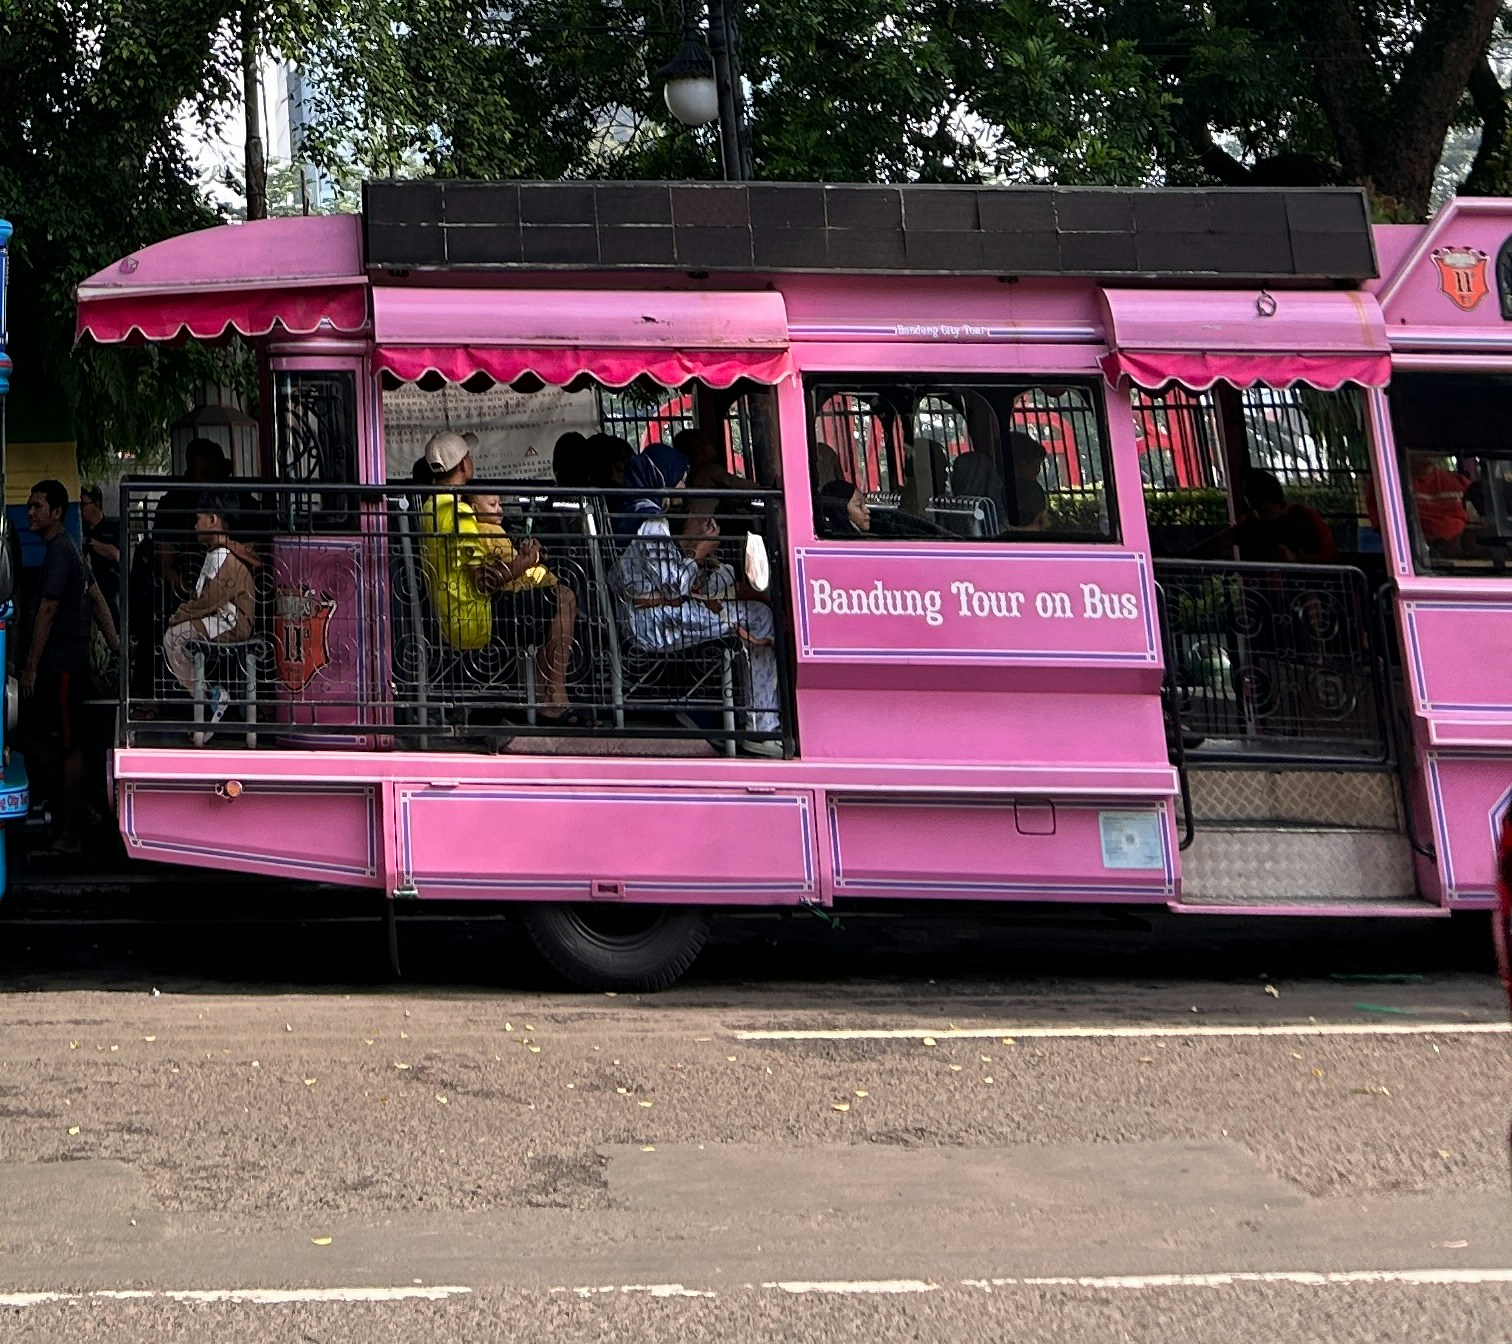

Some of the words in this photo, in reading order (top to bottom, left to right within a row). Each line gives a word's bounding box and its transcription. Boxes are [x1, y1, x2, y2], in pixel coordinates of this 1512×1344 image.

[896, 324, 939, 338] Bandung
[940, 324, 960, 339] City
[962, 324, 986, 336] Tour
[810, 579, 944, 626] Bandung
[950, 580, 1025, 618] Tour
[1035, 591, 1074, 618] on
[1080, 582, 1138, 619] Bus
[283, 626, 303, 663] 11
